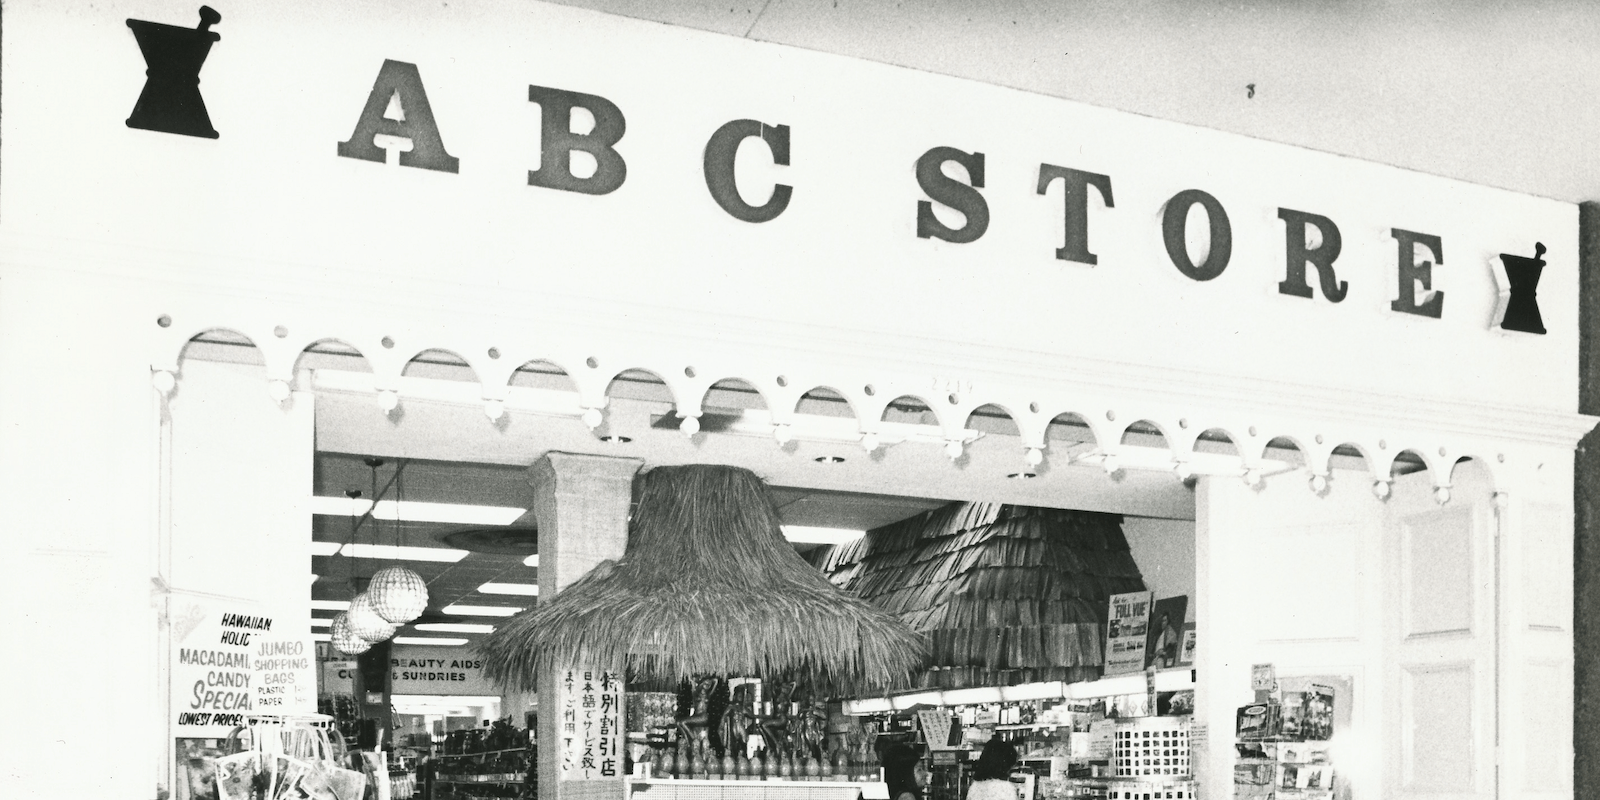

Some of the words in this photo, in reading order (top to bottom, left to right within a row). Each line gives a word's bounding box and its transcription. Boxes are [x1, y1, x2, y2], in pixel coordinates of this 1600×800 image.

[338, 59, 793, 223] ABC
[916, 147, 1443, 318] STORE
[221, 612, 273, 631] HAWAIIAN
[220, 630, 260, 647] HOLID
[257, 640, 304, 657] JUMBO
[179, 648, 251, 670] MACADAMI
[254, 658, 309, 671] SHOPPING
[391, 659, 445, 669] BEAUTY
[450, 660, 481, 669] AIDS
[207, 670, 251, 688] CANDY
[264, 672, 296, 685] BAGS
[402, 671, 466, 681] SUNDRIES
[257, 686, 286, 695] PLASTIC
[258, 697, 283, 706] PAPER
[178, 712, 212, 726] LOWEST
[600, 671, 618, 777] 特別割引店
